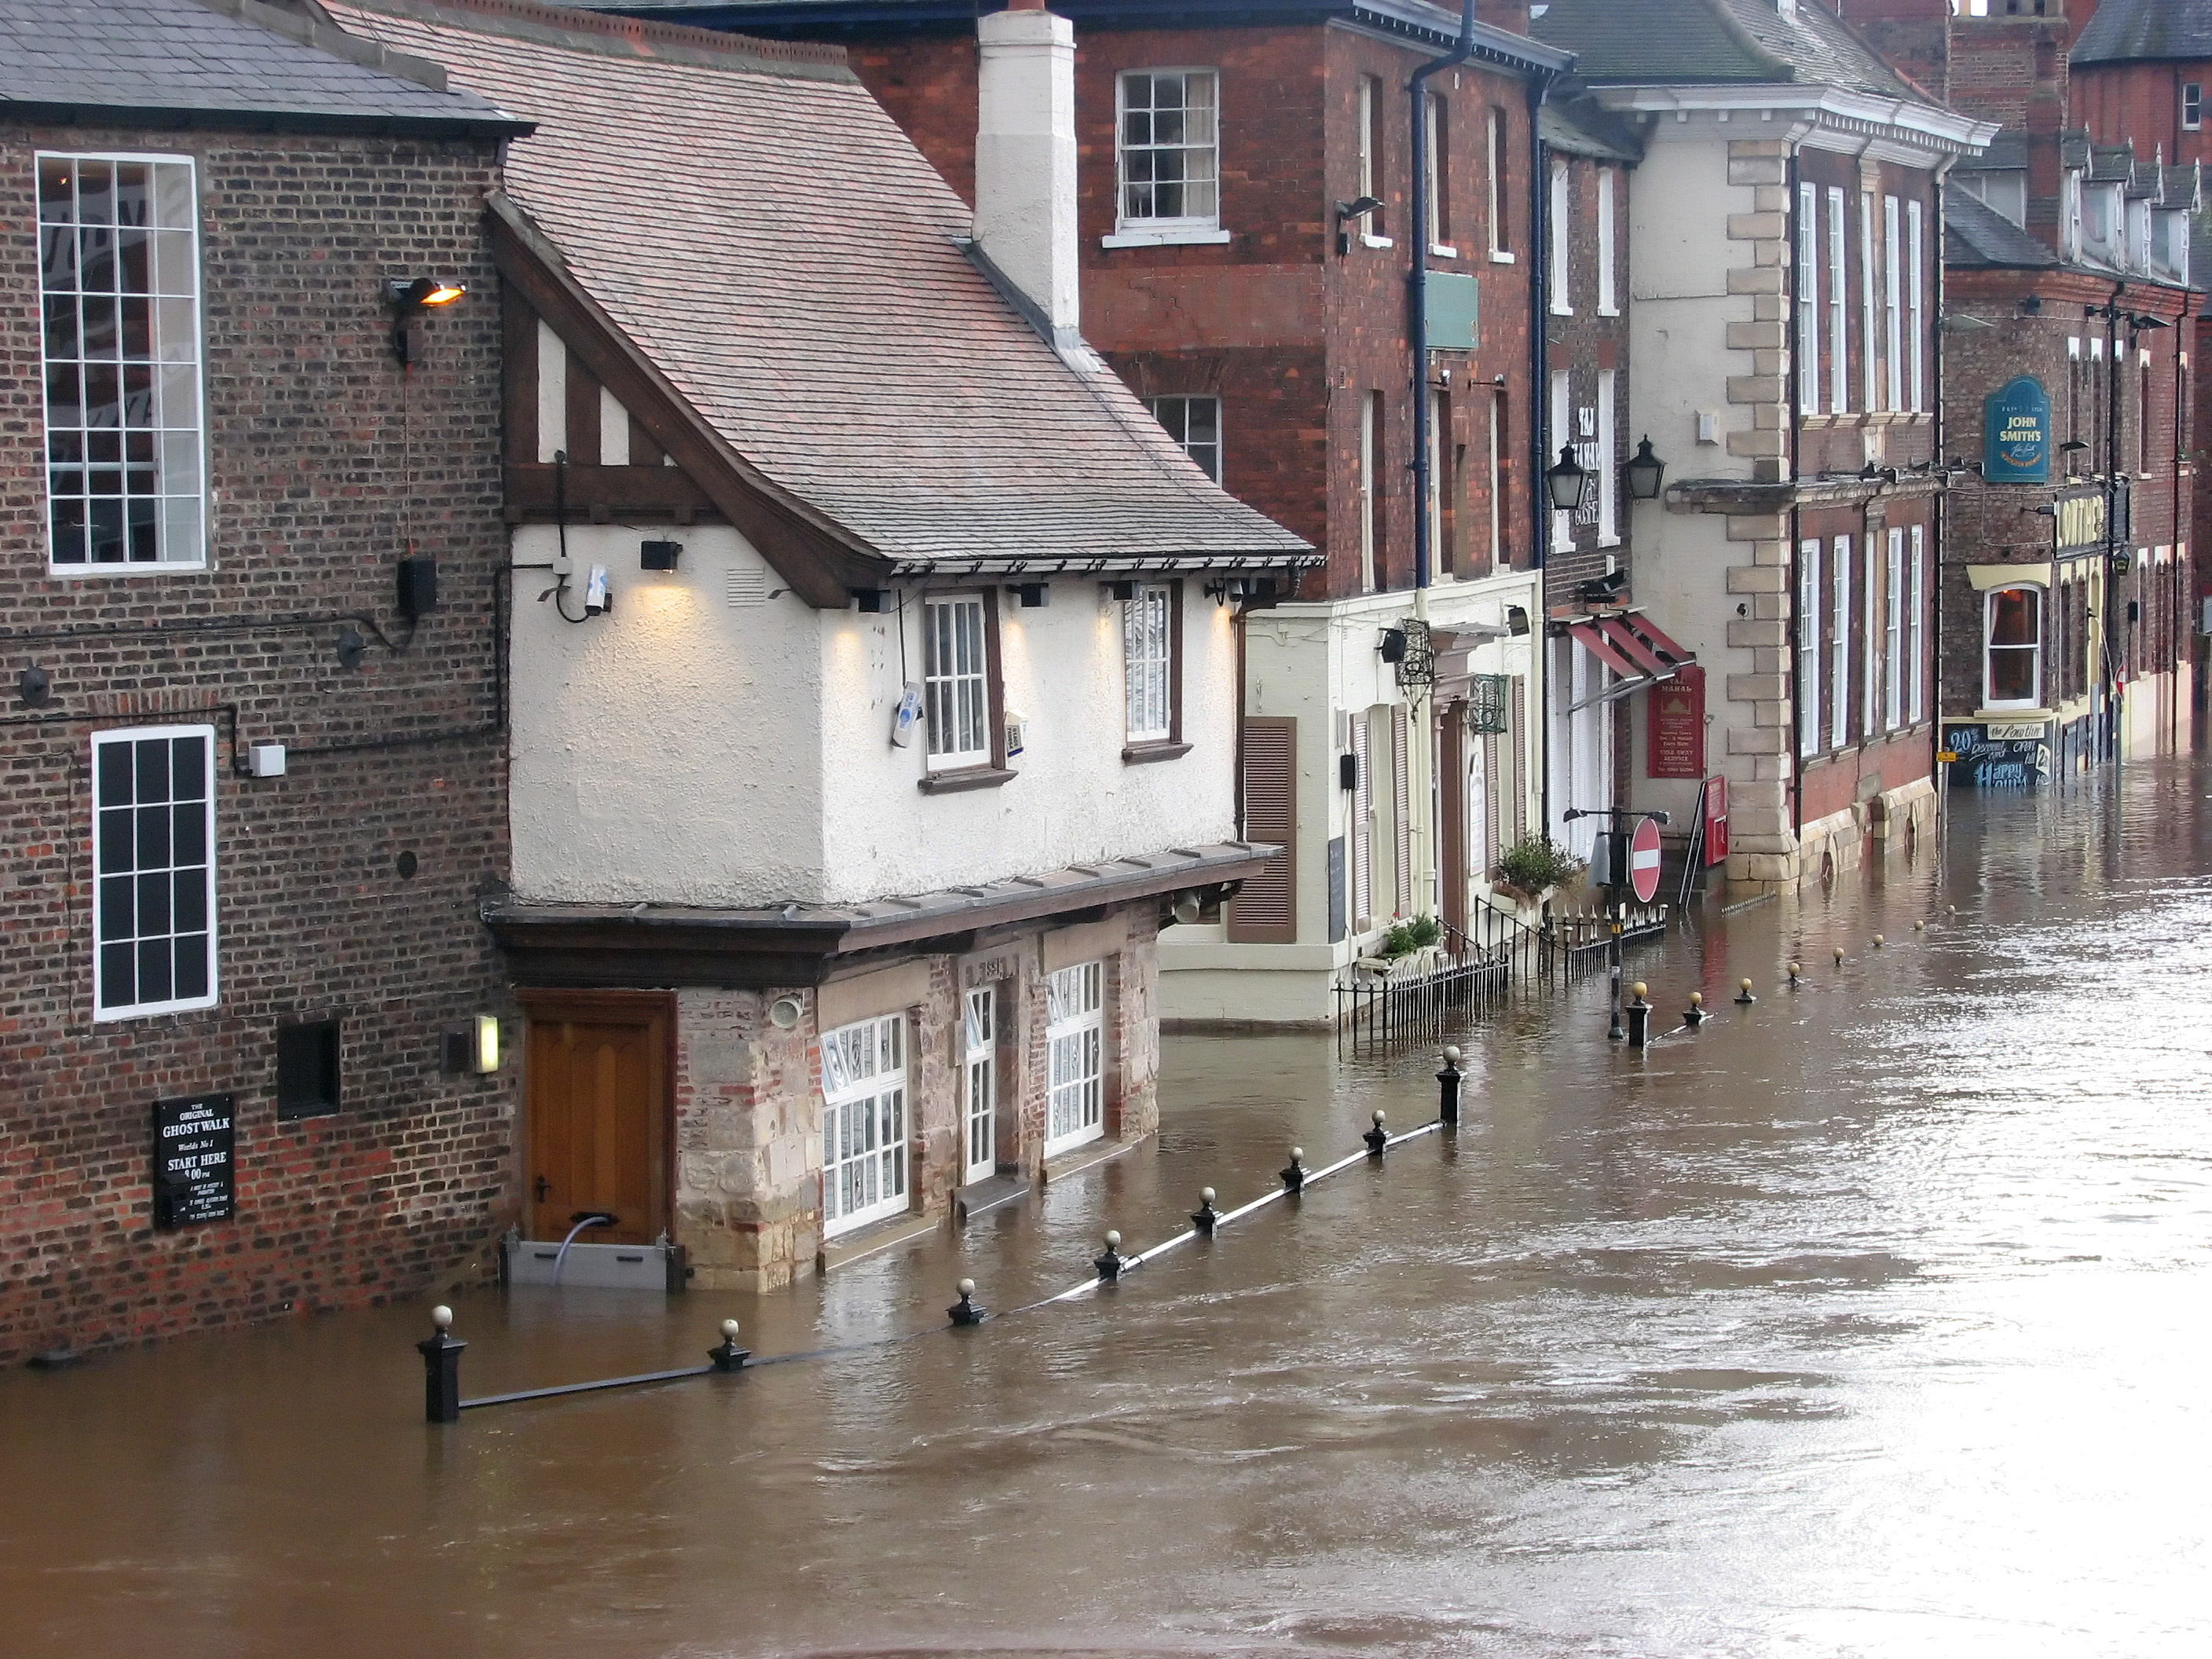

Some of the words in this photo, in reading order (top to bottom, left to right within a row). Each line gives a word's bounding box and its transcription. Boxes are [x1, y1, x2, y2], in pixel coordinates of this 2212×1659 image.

[1579, 407, 1594, 436] TAJ
[2007, 417, 2037, 429] JOHN
[1999, 430, 2042, 441] SMITH'S
[179, 1108, 214, 1121] ORIGINAL
[163, 1122, 200, 1138] GHOST
[200, 1118, 230, 1132] WALK
[167, 1155, 197, 1170] START
[200, 1152, 227, 1166] HERE
